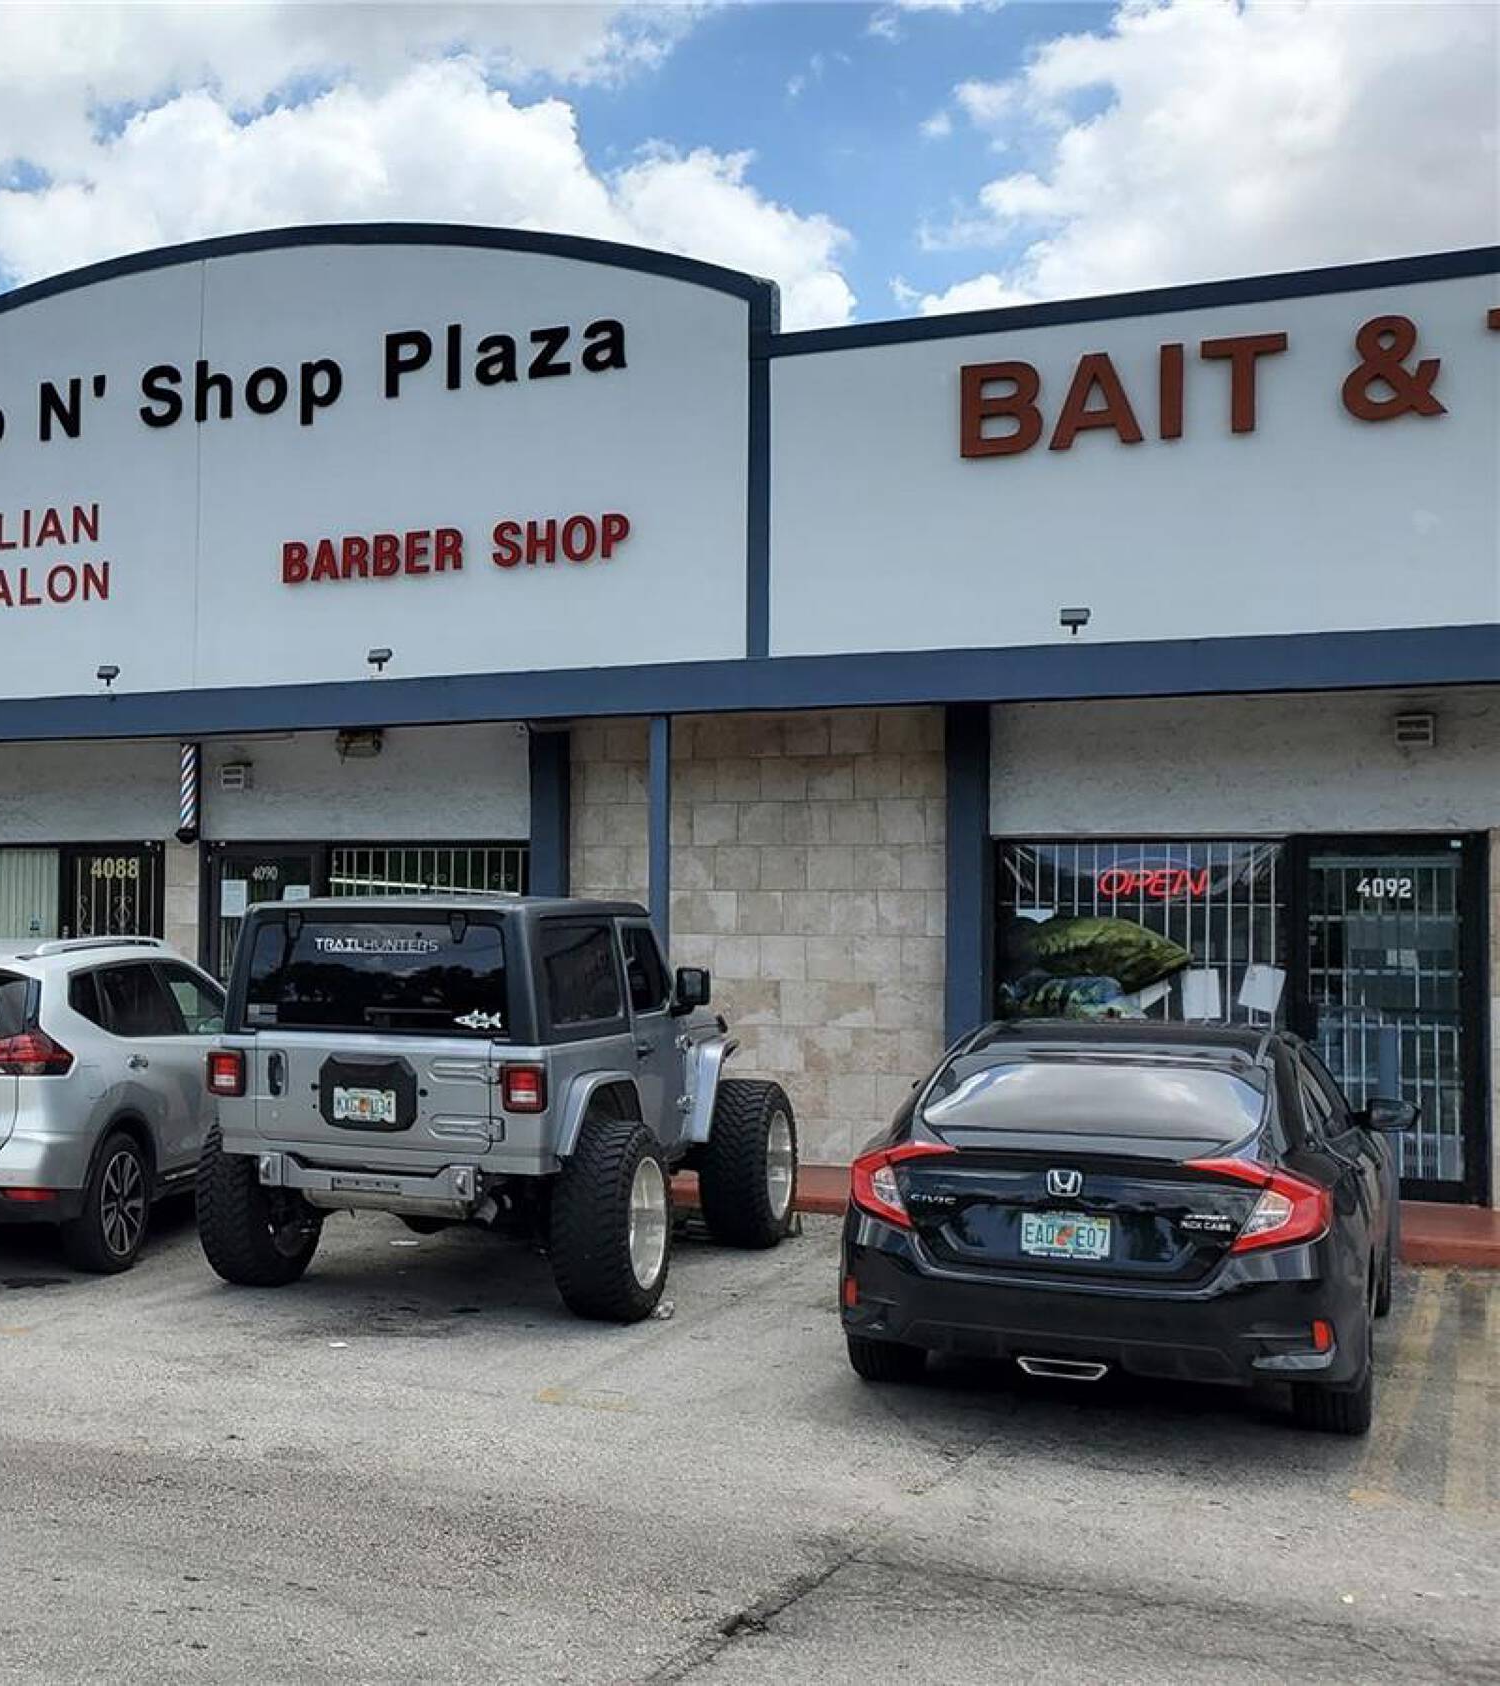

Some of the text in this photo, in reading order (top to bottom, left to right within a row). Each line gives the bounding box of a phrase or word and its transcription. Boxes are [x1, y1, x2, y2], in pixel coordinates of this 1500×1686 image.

[39, 374, 107, 442] N'
[138, 357, 343, 429] Shop
[384, 318, 628, 399] Plaza
[959, 313, 1448, 458] BAIT &
[282, 512, 631, 586] BARBER SHOP
[90, 857, 140, 879] 4088
[252, 865, 278, 880] 4090
[1097, 868, 1208, 897] OPEN
[1357, 877, 1413, 898] 4092
[910, 1193, 957, 1205] CIVIC
